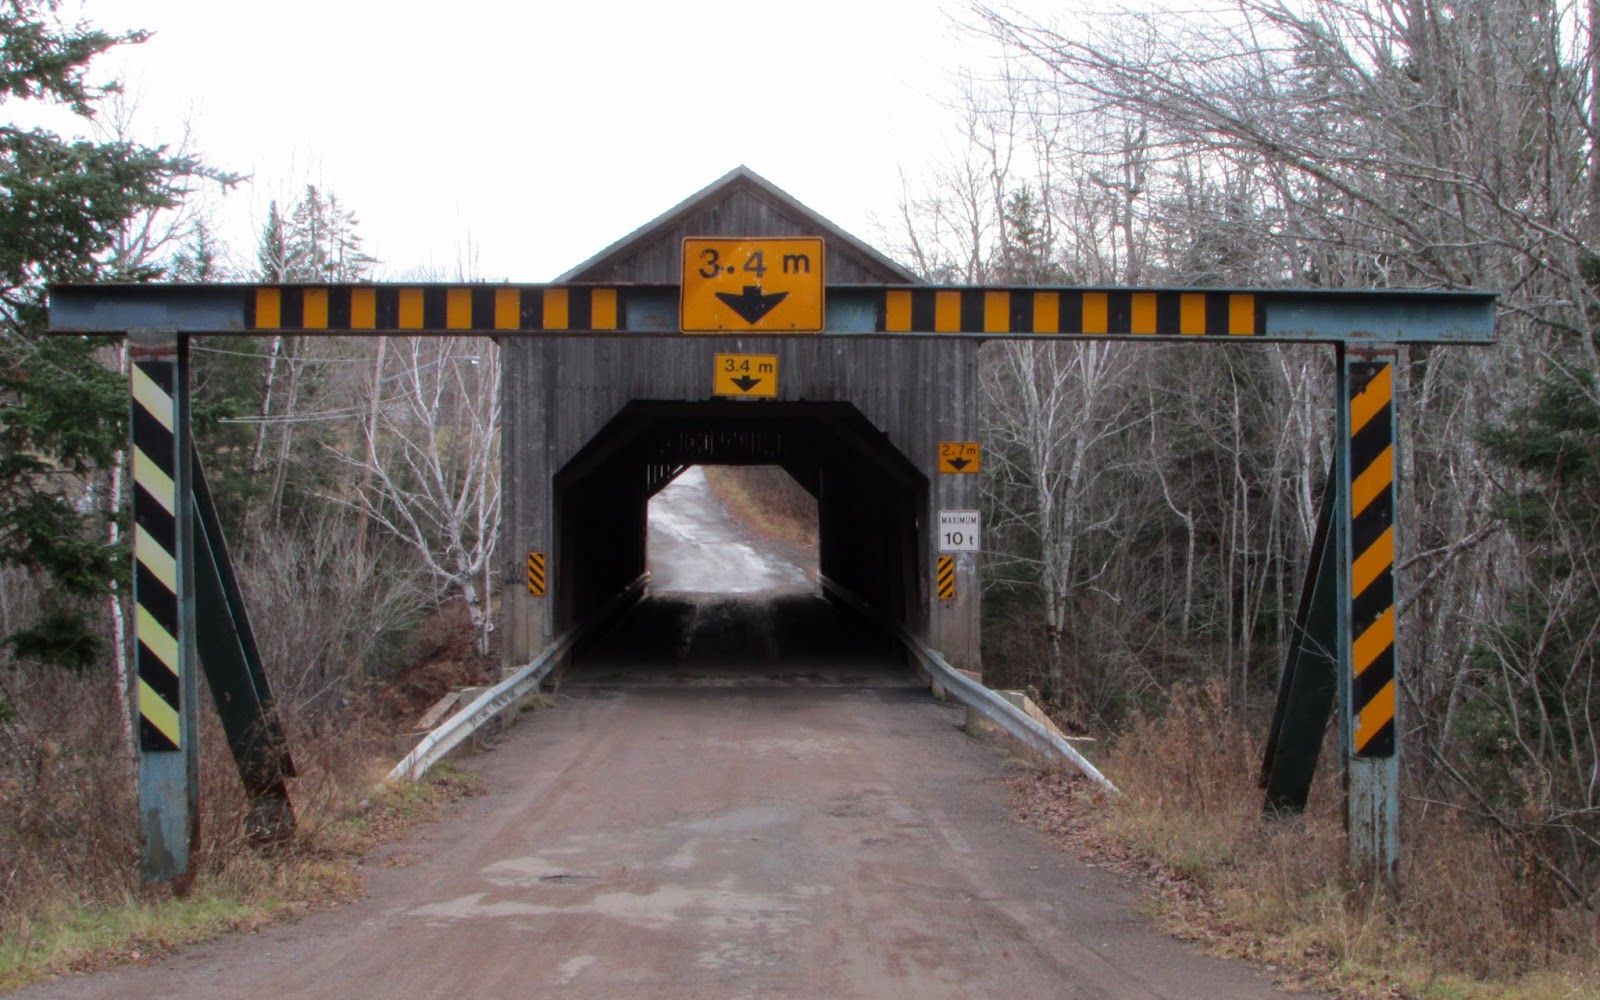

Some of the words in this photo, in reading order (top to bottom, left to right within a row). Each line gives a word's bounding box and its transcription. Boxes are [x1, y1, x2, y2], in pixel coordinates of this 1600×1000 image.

[698, 248, 767, 279] 3.4
[783, 253, 810, 274] m
[724, 358, 750, 373] 3.4
[758, 362, 773, 374] m
[941, 516, 977, 525] MAXIMUM
[944, 531, 964, 546] 10
[968, 535, 974, 546] t
